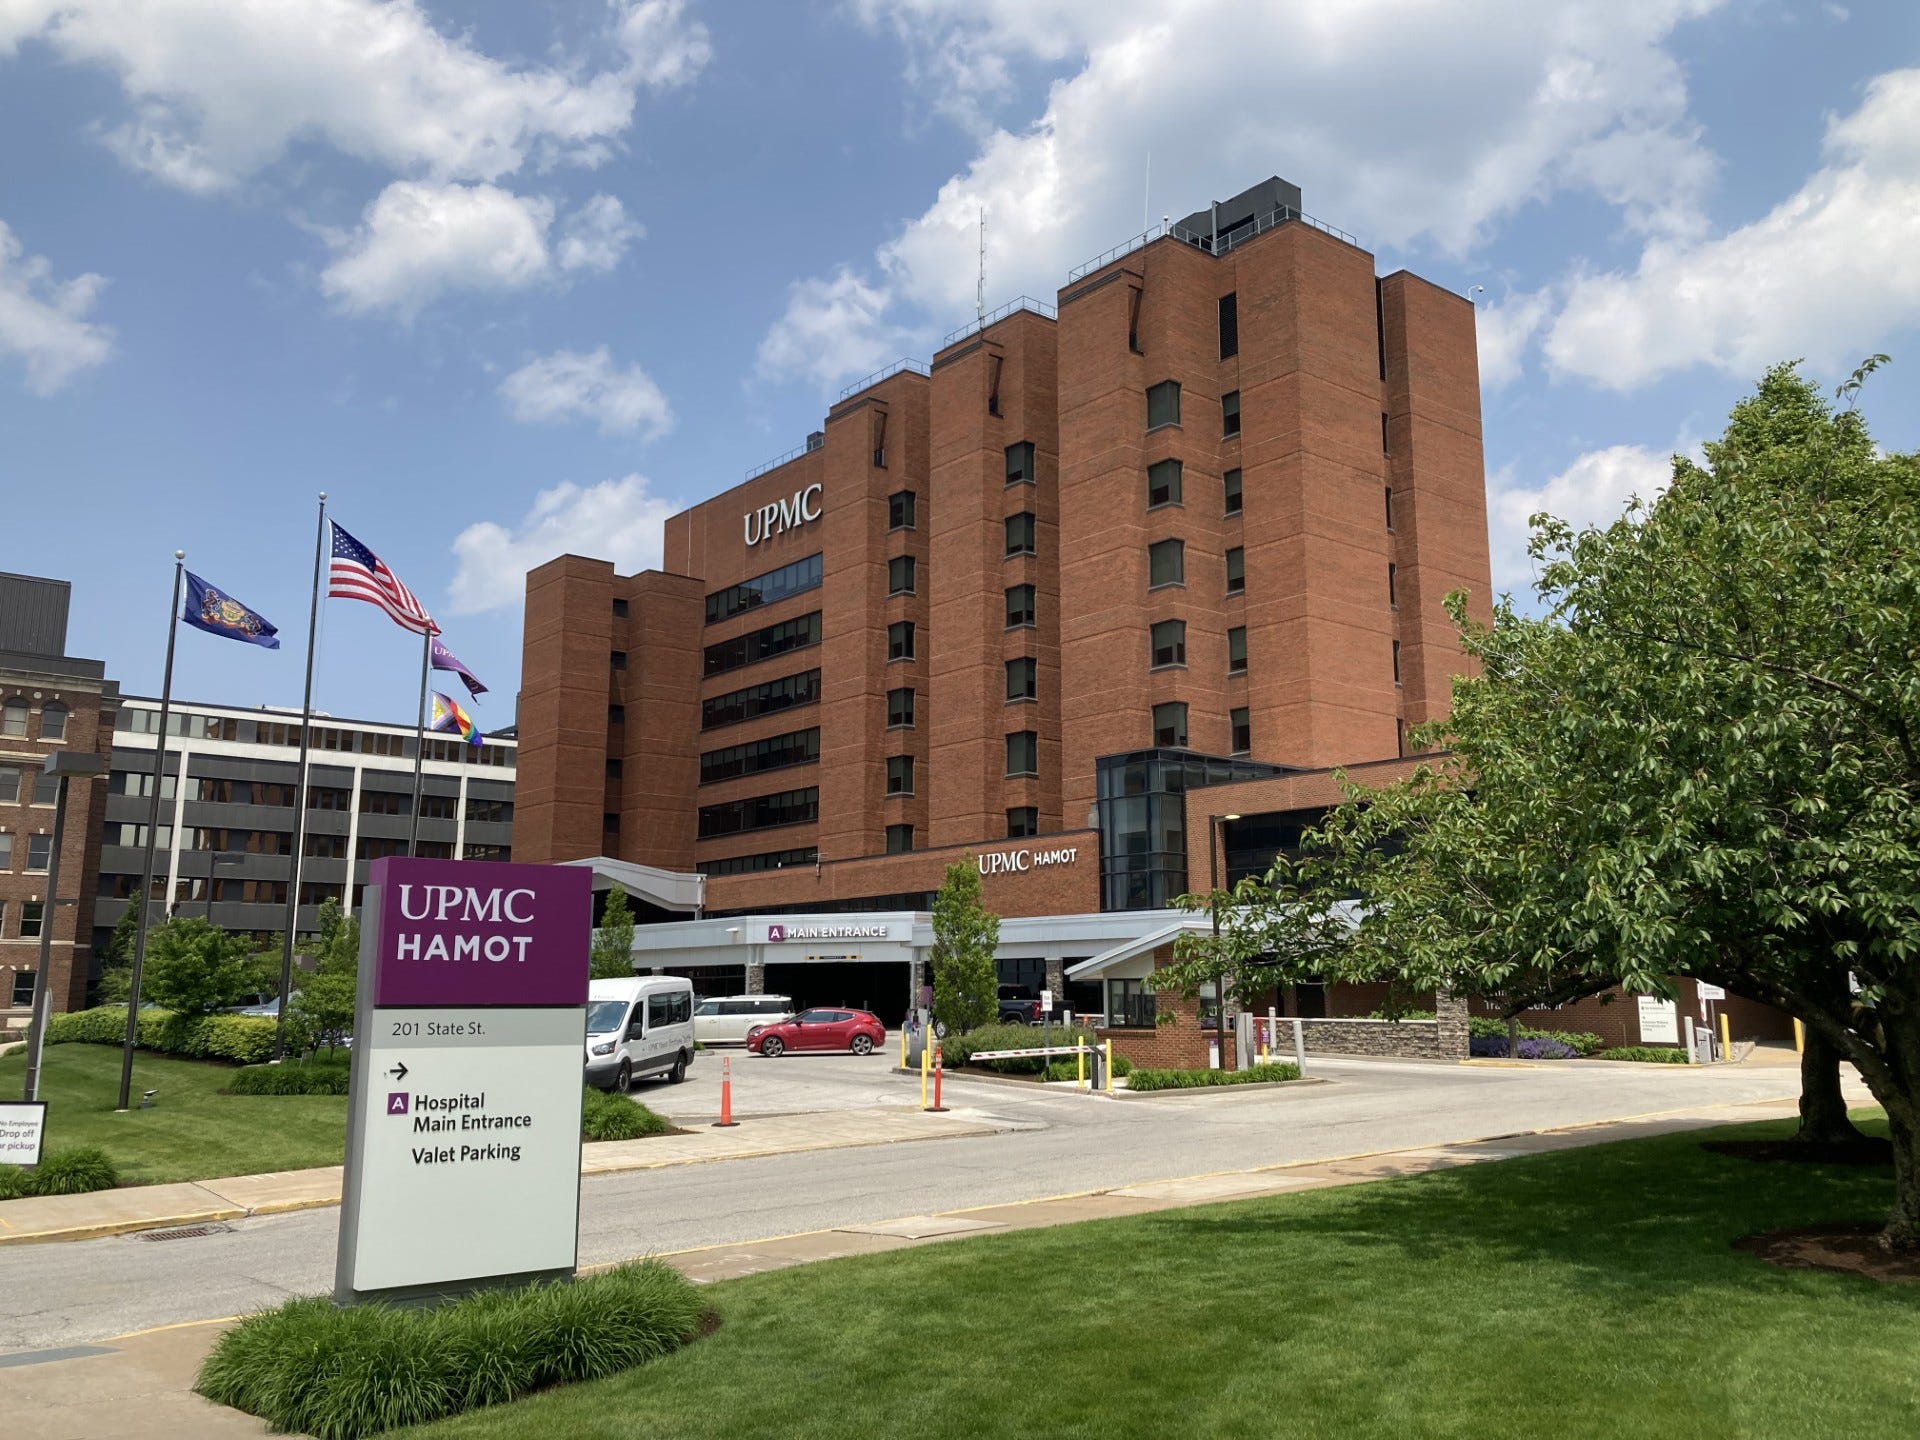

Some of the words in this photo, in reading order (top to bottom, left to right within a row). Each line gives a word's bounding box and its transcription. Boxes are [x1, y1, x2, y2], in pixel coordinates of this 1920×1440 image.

[743, 483, 822, 546] UPMC
[978, 850, 1030, 875] UPMC
[1033, 848, 1077, 866] HAMOT
[398, 884, 536, 923] UPMC
[770, 927, 781, 939] A
[787, 927, 818, 938] MAIN
[821, 926, 887, 938] ENTRANCE
[397, 933, 533, 962] HAMOT
[391, 1022, 420, 1036] 201
[427, 1022, 465, 1036] State
[468, 1022, 486, 1035] St.
[391, 1096, 405, 1110] A
[414, 1092, 485, 1113] Hospital
[0, 1129, 20, 1139] Drop
[413, 1115, 457, 1133] Main
[461, 1114, 532, 1130] Entrance
[7, 1142, 35, 1151] pickup
[411, 1146, 457, 1165] Valet
[459, 1142, 522, 1162] Parking
